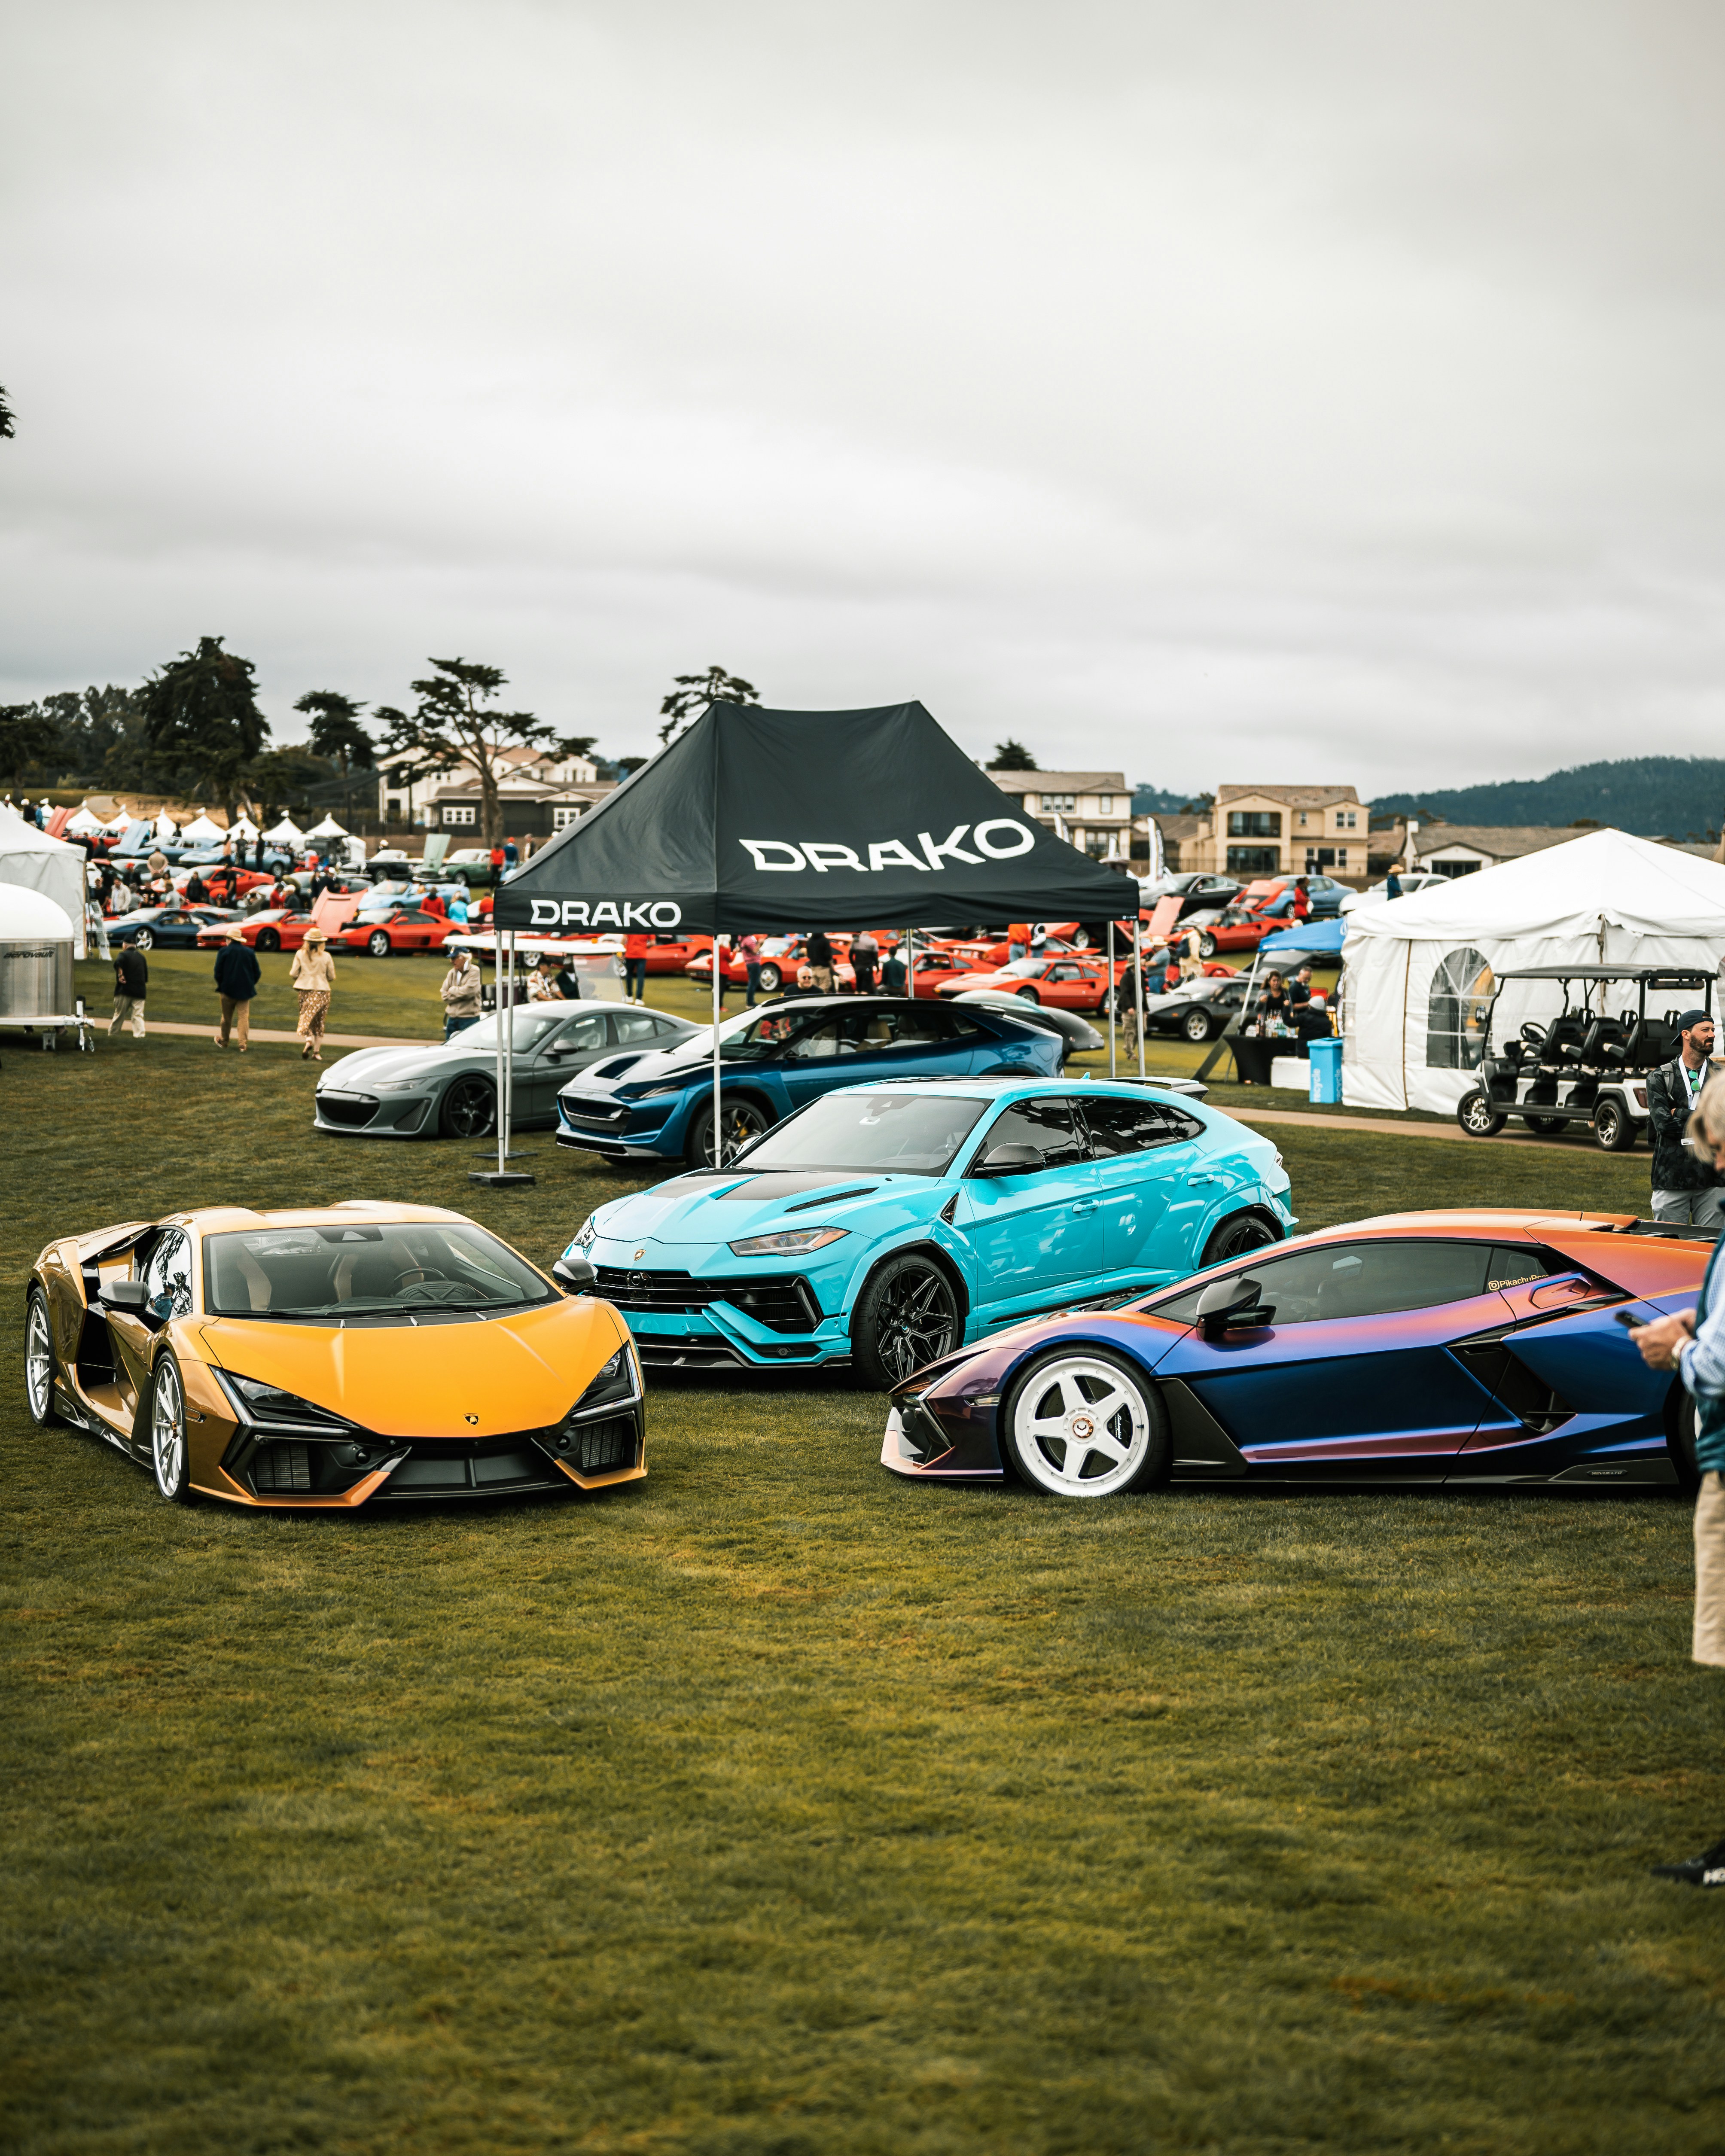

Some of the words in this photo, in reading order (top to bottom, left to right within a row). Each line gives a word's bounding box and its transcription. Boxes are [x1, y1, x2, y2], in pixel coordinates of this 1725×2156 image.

[738, 818, 1035, 872] DRAKO
[531, 899, 681, 928] DRAKO
[3, 950, 55, 959] aerovault
[1312, 1068, 1323, 1102] recycle
[875, 1268, 893, 1297] ZERO
